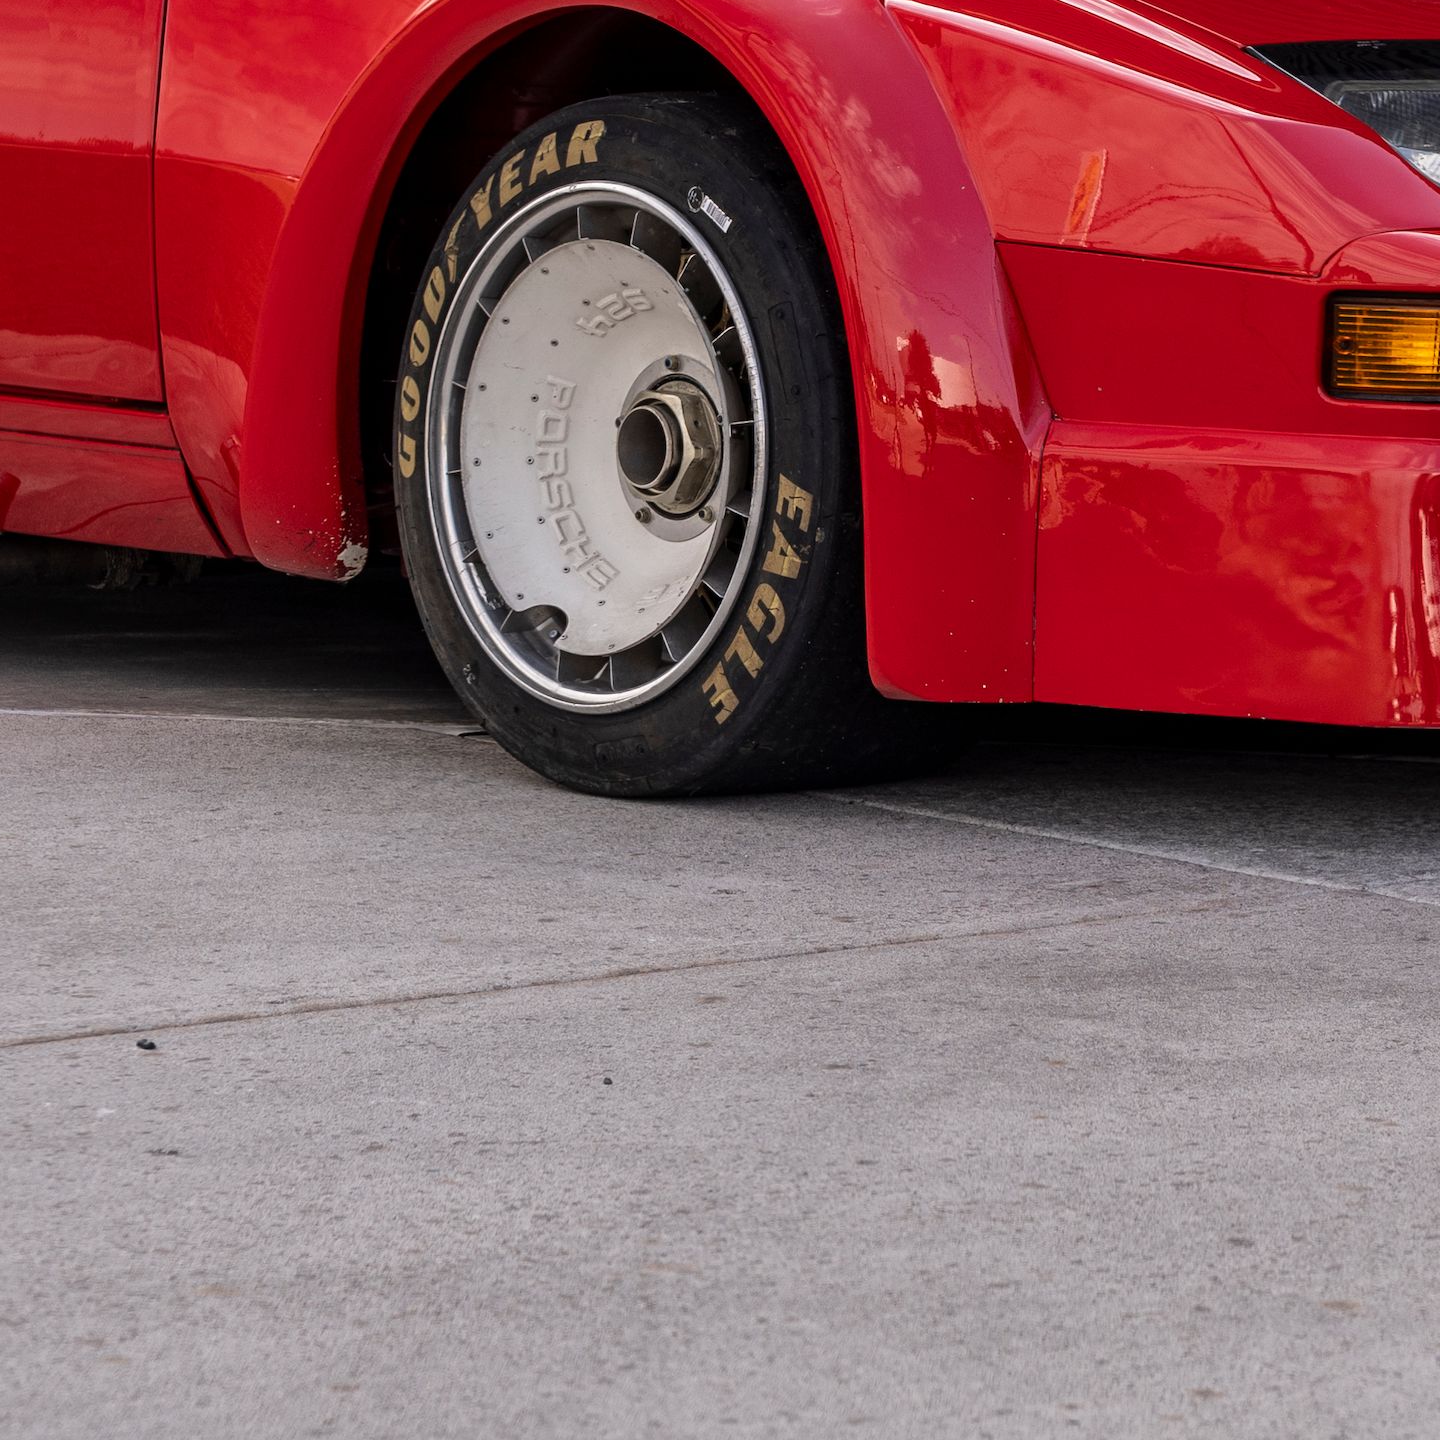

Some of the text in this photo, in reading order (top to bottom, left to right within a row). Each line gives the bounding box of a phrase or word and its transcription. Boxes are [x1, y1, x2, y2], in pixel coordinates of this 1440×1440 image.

[398, 119, 606, 479] GOODYEAR
[576, 288, 655, 338] 924
[536, 375, 621, 592] PORSCHE
[702, 472, 813, 725] EAGLE
